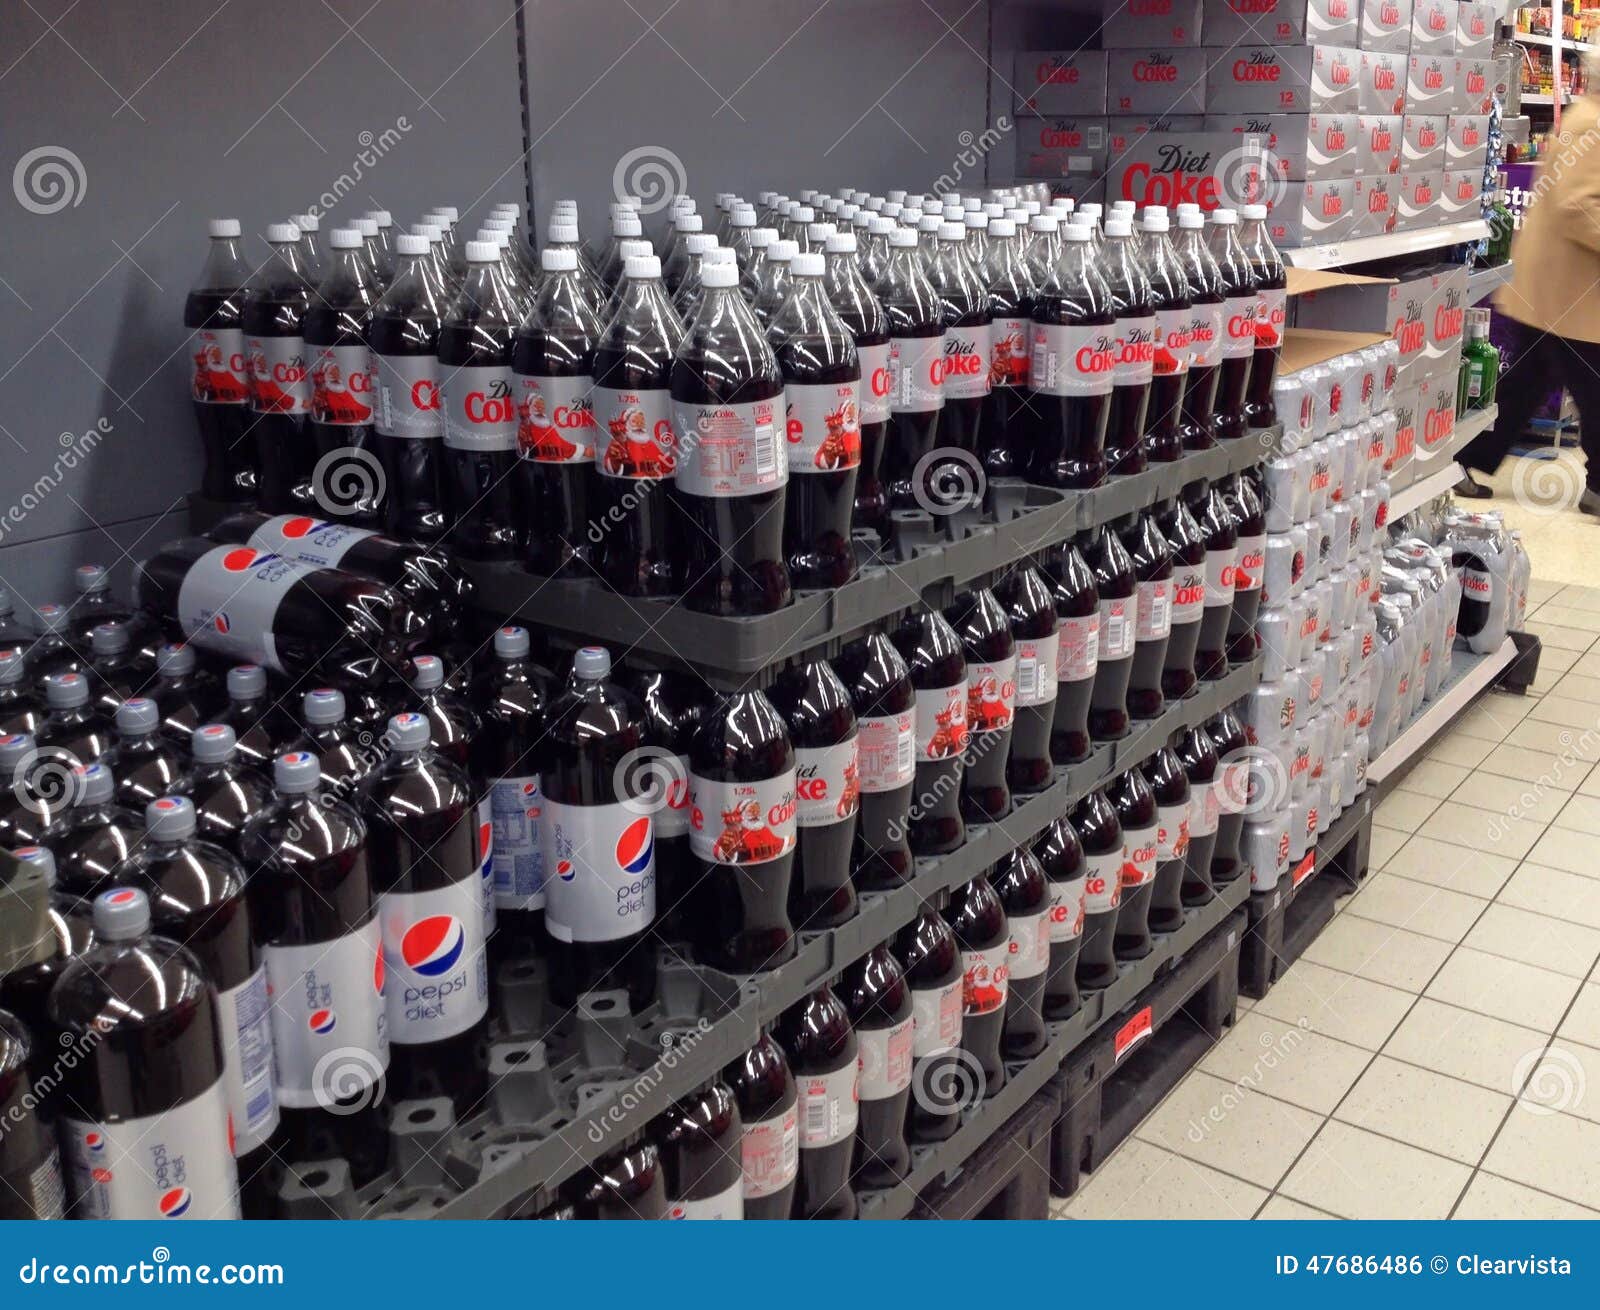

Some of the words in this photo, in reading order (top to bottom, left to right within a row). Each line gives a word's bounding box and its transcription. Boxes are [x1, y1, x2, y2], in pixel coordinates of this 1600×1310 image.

[1276, 23, 1291, 36] 12
[1250, 51, 1277, 65] Diet
[1036, 61, 1080, 85] Coke
[1132, 60, 1178, 83] Coke
[1232, 59, 1281, 82] Coke
[1374, 64, 1396, 91] Coke
[1279, 91, 1294, 104] 12
[1040, 127, 1082, 149] Coke
[1246, 119, 1273, 134] Diet
[1326, 127, 1346, 151] Coke
[1371, 127, 1392, 152] Coke
[1152, 144, 1212, 174] Diet
[1121, 162, 1223, 212] Coke
[1322, 193, 1343, 216] Coke
[1369, 188, 1390, 214] Coke
[1435, 304, 1464, 342] Coke
[944, 339, 976, 354] Diet
[1423, 408, 1455, 446] Coke
[617, 897, 646, 917] diet
[404, 970, 467, 1006] pepsi
[405, 1002, 446, 1022] diet
[152, 1143, 171, 1190] pepsi
